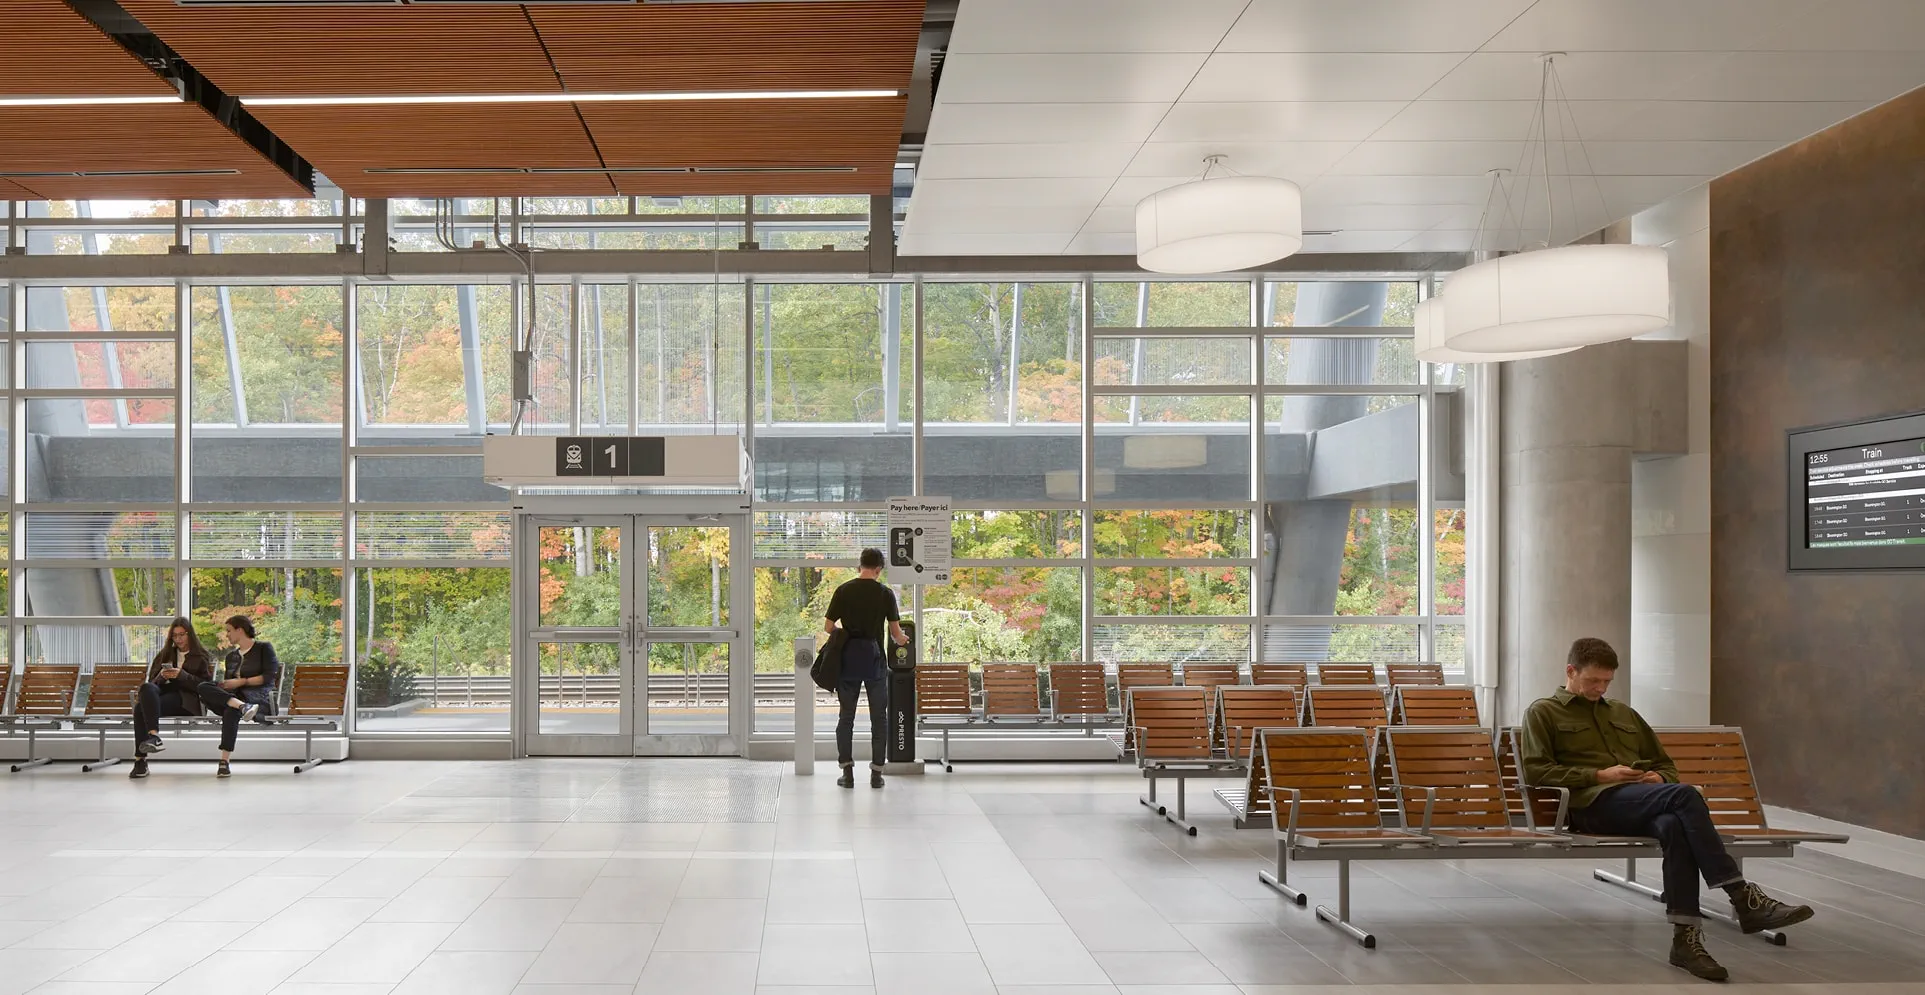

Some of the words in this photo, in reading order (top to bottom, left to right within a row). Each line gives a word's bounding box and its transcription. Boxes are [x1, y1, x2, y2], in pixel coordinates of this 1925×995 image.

[605, 445, 616, 468] 1
[1862, 448, 1882, 459] Train
[1810, 454, 1828, 464] 12:55
[891, 504, 903, 512] Pay
